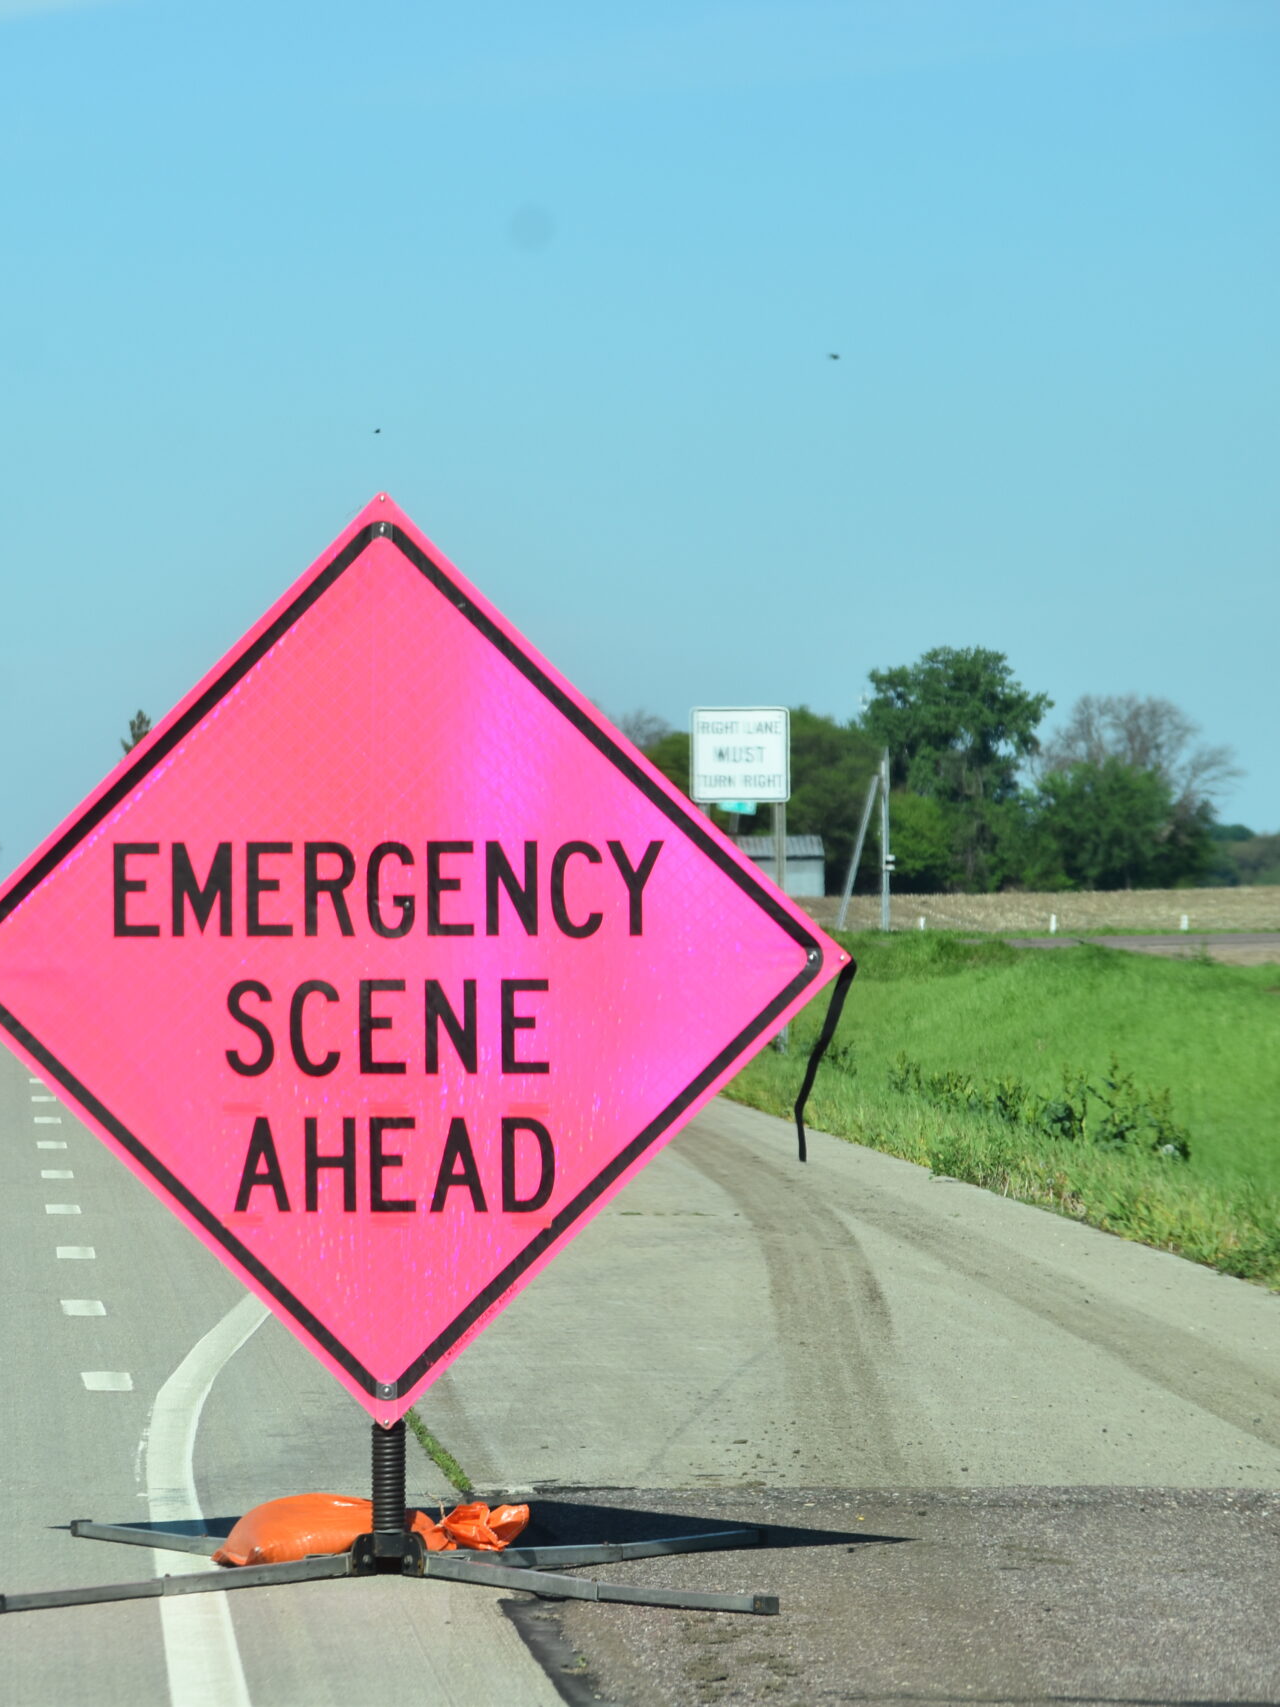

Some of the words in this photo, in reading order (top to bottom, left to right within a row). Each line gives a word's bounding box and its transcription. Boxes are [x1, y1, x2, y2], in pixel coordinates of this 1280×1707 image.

[697, 721, 738, 734] RIGHT
[745, 721, 782, 734] LANE
[714, 746, 766, 763] MUST
[698, 774, 736, 788] TURN
[744, 774, 782, 788] RIGHT
[113, 841, 664, 939] EMERGENCY
[225, 979, 550, 1077] SCENE
[234, 1117, 555, 1213] AHEAD
